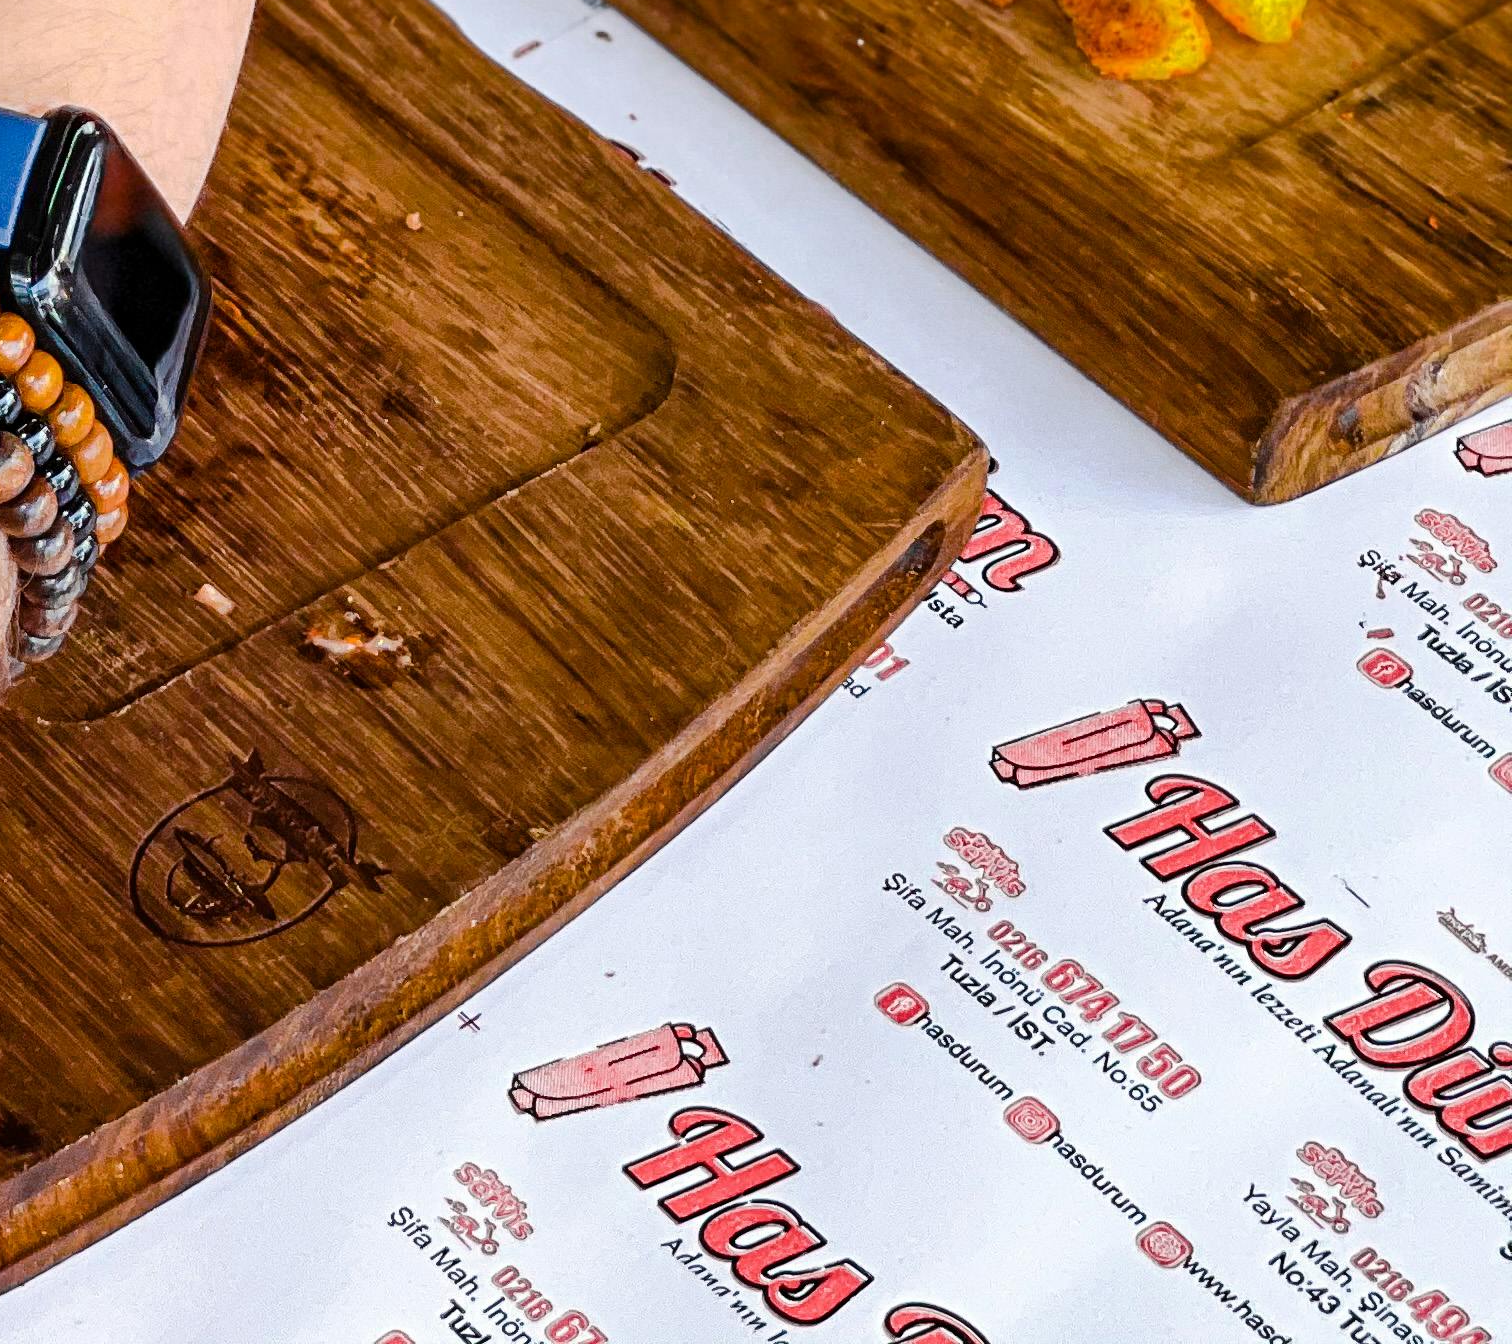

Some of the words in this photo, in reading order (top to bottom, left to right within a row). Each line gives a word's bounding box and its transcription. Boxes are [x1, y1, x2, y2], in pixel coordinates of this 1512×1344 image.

[922, 591, 965, 629] sta
[1400, 581, 1450, 625] Mah.
[1417, 623, 1475, 675] Tuzla
[1394, 674, 1497, 759] hasdurum
[1102, 773, 1353, 981] Has
[882, 873, 927, 911] Şifa
[925, 907, 974, 955] Mah.
[1043, 1004, 1091, 1054] Cad.
[1092, 1051, 1164, 1114] No:65
[939, 952, 998, 1008] Tuzla
[987, 920, 1049, 971] 0216
[1041, 958, 1120, 1023] 674
[1101, 1012, 1158, 1054] 17
[1136, 1043, 1202, 1100] 50
[1143, 894, 1252, 986] Adana'nın
[1250, 983, 1322, 1043] lezzeti
[913, 1012, 1015, 1102] hasdurum
[1044, 1129, 1148, 1226] hasdurum
[387, 1207, 433, 1250] Şifa
[430, 1246, 479, 1302] Mah.
[622, 1105, 875, 1326] Has
[1243, 1183, 1301, 1243] Yayla
[1300, 1239, 1354, 1293] Mah.
[1268, 1251, 1341, 1315] No:43
[1350, 1247, 1414, 1302] 0216
